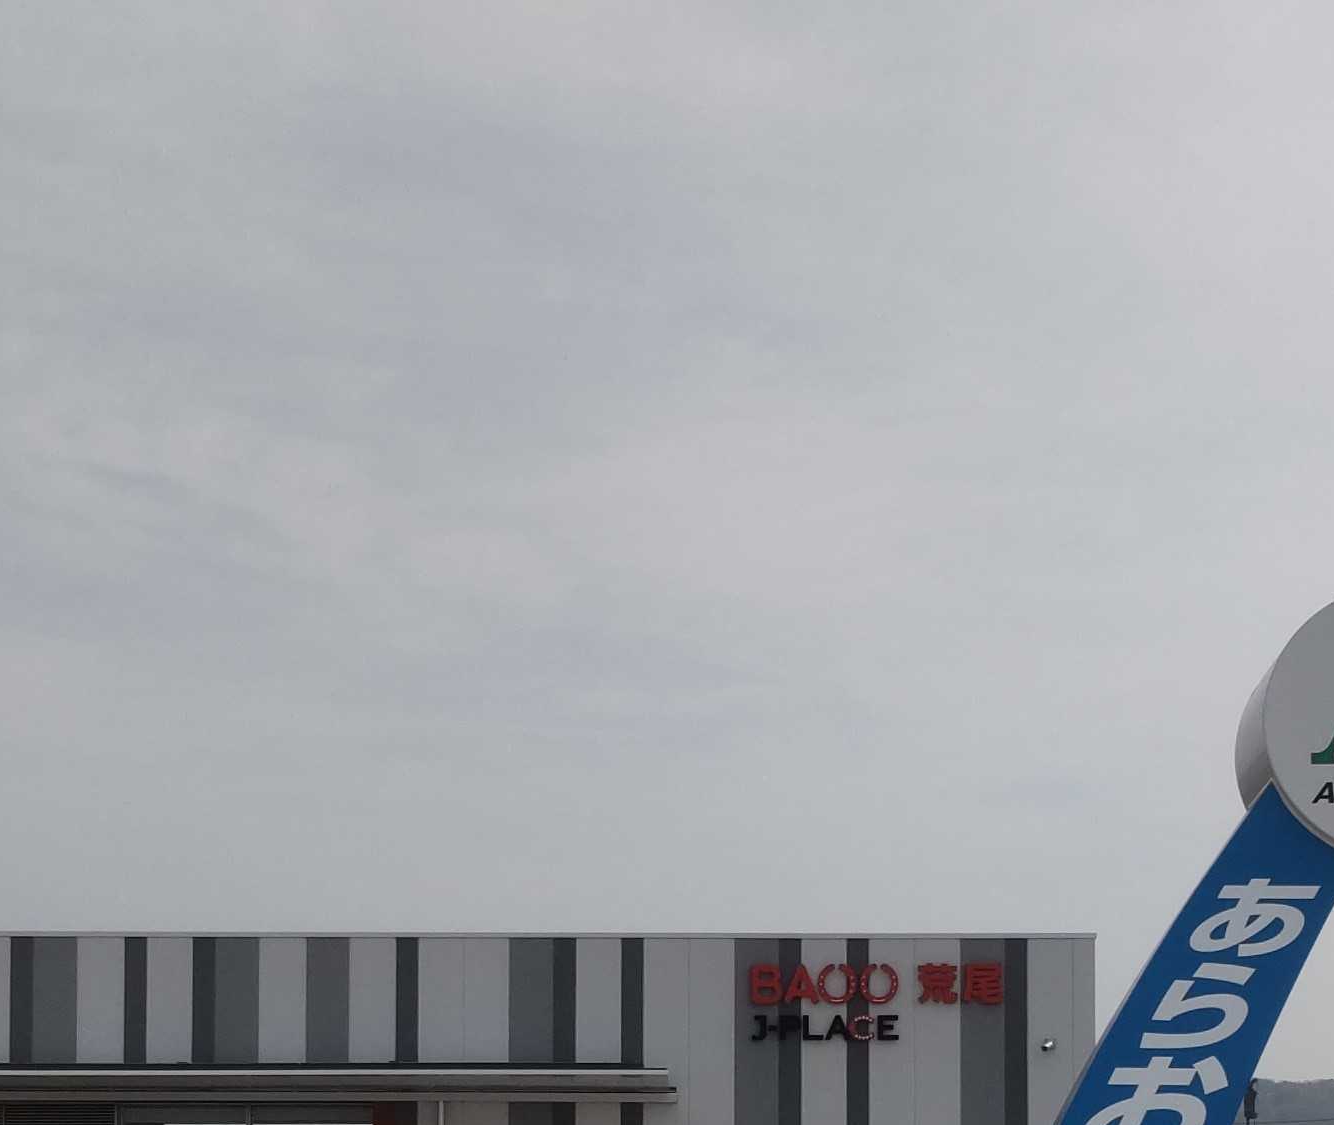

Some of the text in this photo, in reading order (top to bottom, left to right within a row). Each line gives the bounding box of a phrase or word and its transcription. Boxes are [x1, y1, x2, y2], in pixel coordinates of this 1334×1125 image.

[748, 962, 1004, 1005] BAOO 荒尾
[751, 1014, 899, 1041] J-PLACE
